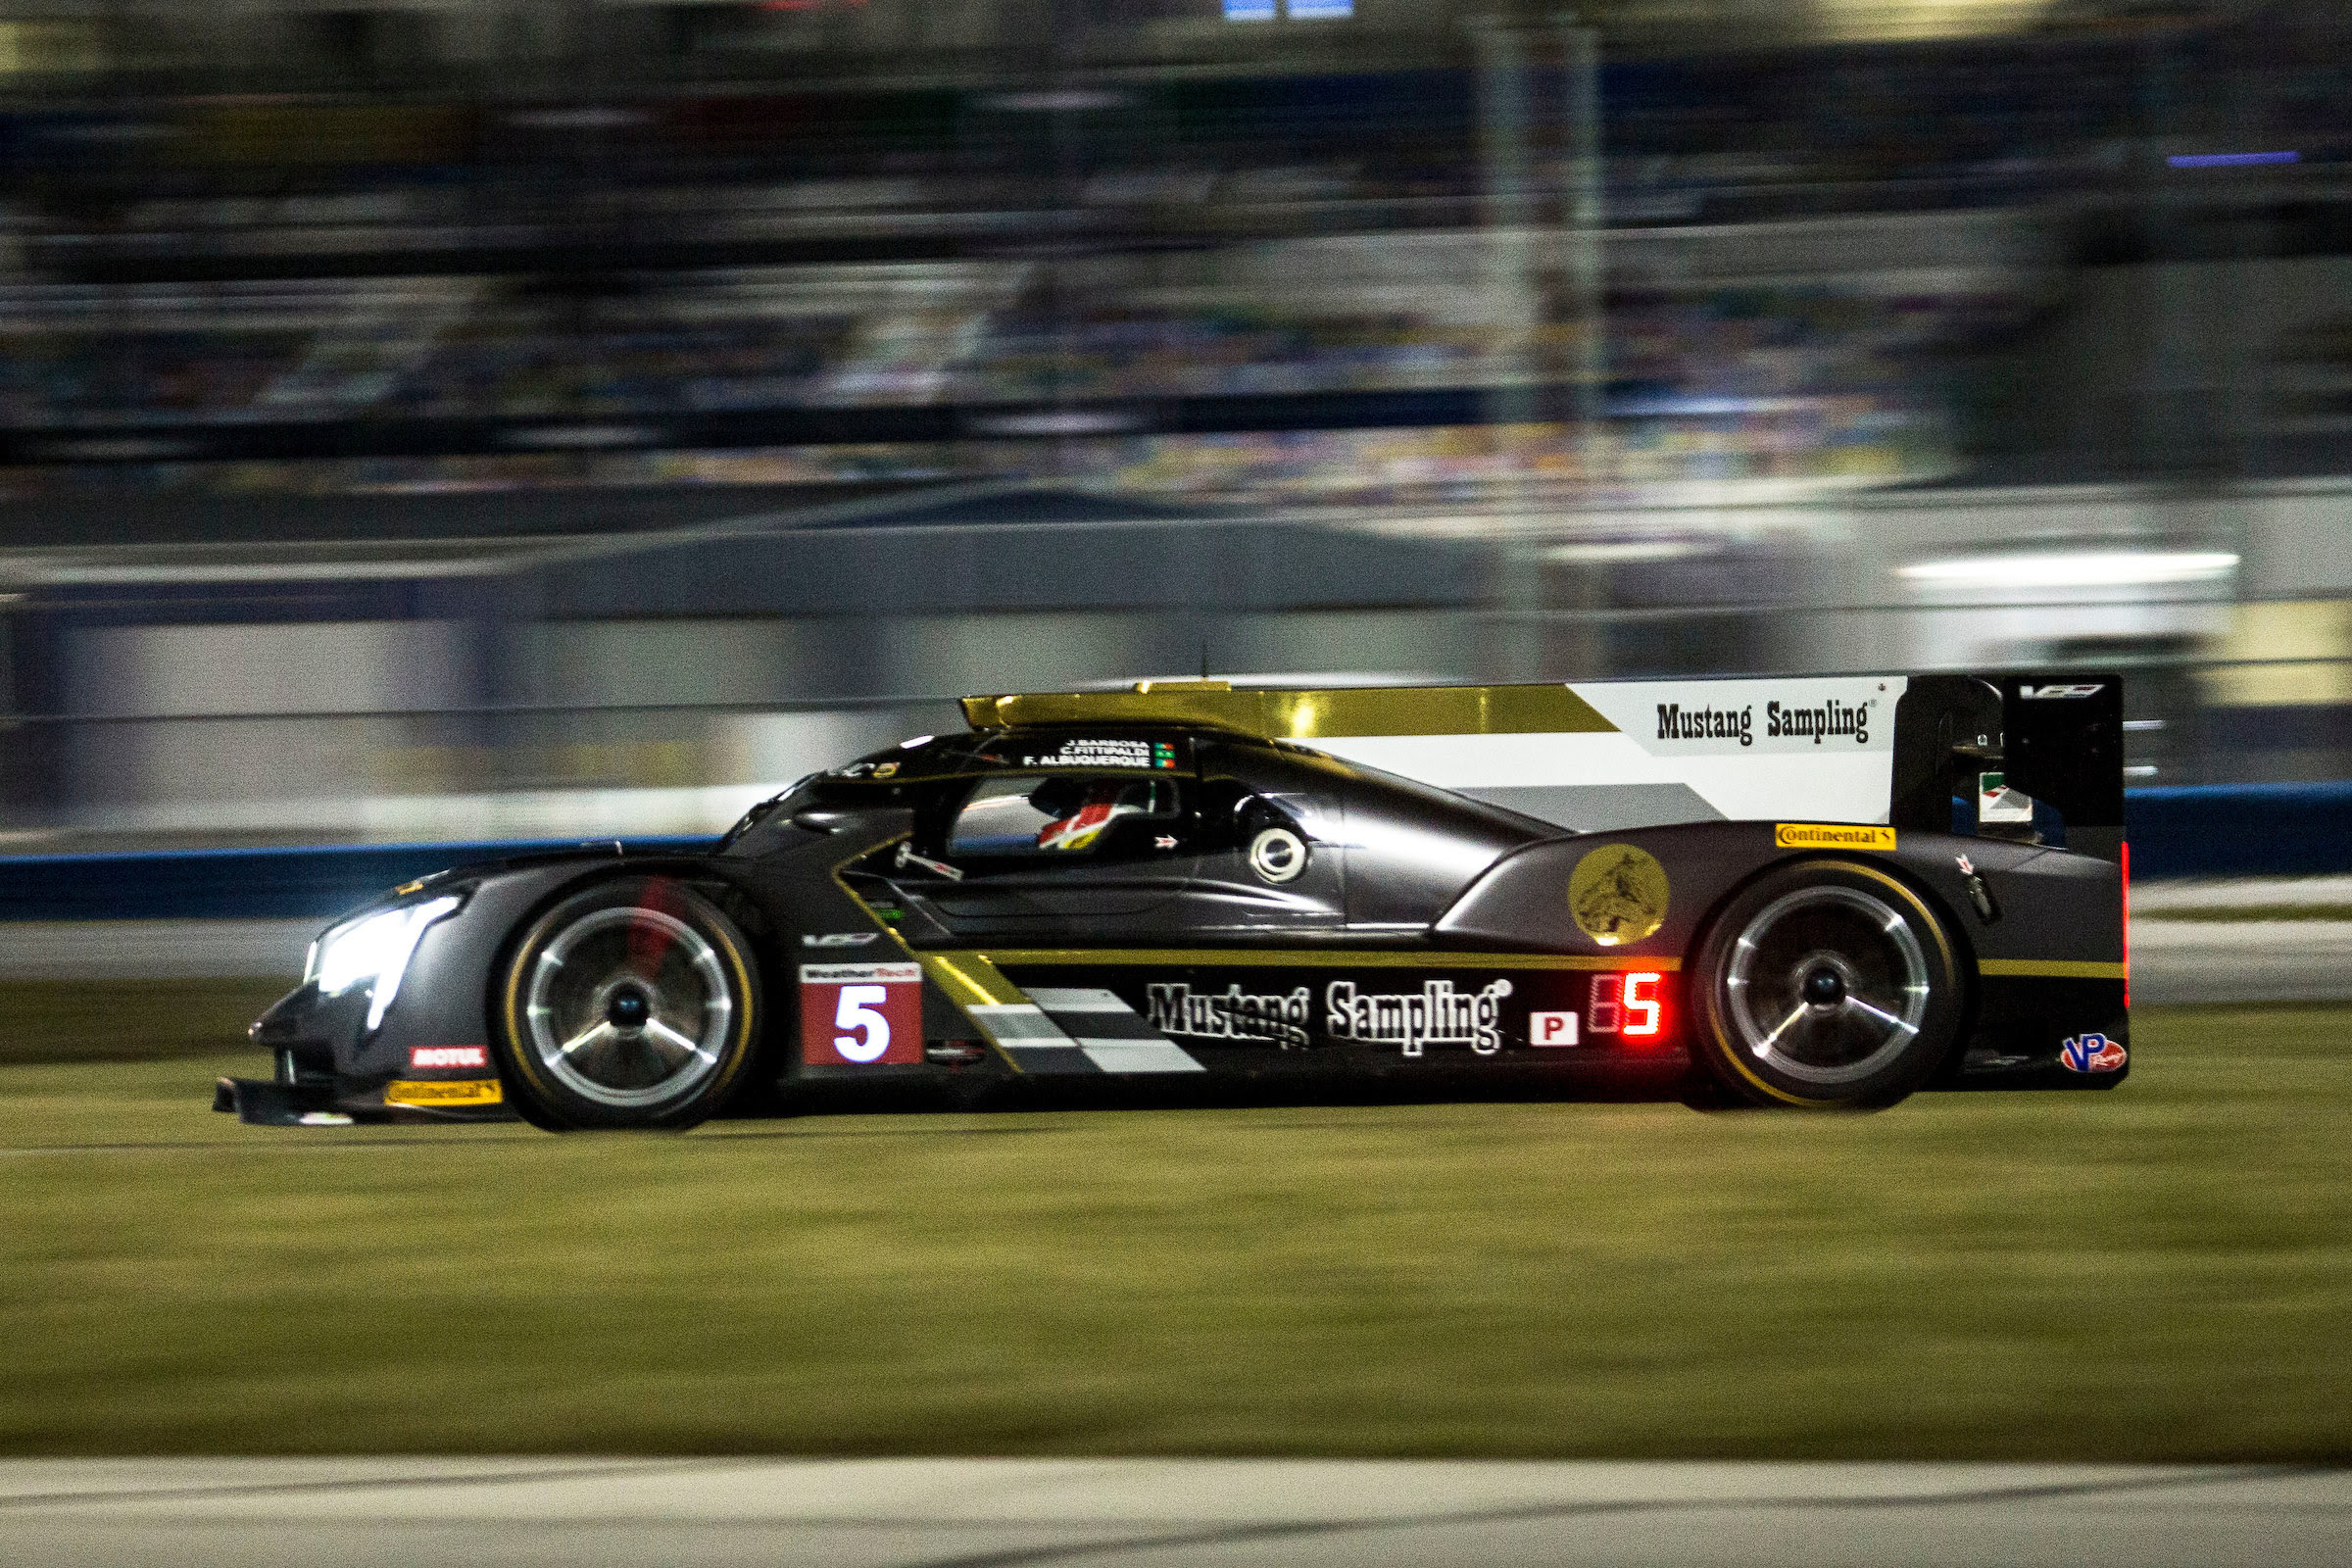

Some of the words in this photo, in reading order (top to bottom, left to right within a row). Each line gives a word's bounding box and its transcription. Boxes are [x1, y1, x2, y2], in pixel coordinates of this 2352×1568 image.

[1656, 703, 1753, 746] Mustang
[1767, 699, 1870, 744] Sampling
[1779, 826, 1877, 845] Continental
[833, 984, 891, 1063] 5
[1147, 983, 1312, 1052] Mustang
[1326, 980, 1502, 1056] Sampling
[1623, 972, 1662, 1037] 5
[1543, 1016, 1566, 1040] P
[414, 1048, 484, 1065] MOTUL
[2063, 1033, 2107, 1072] VP
